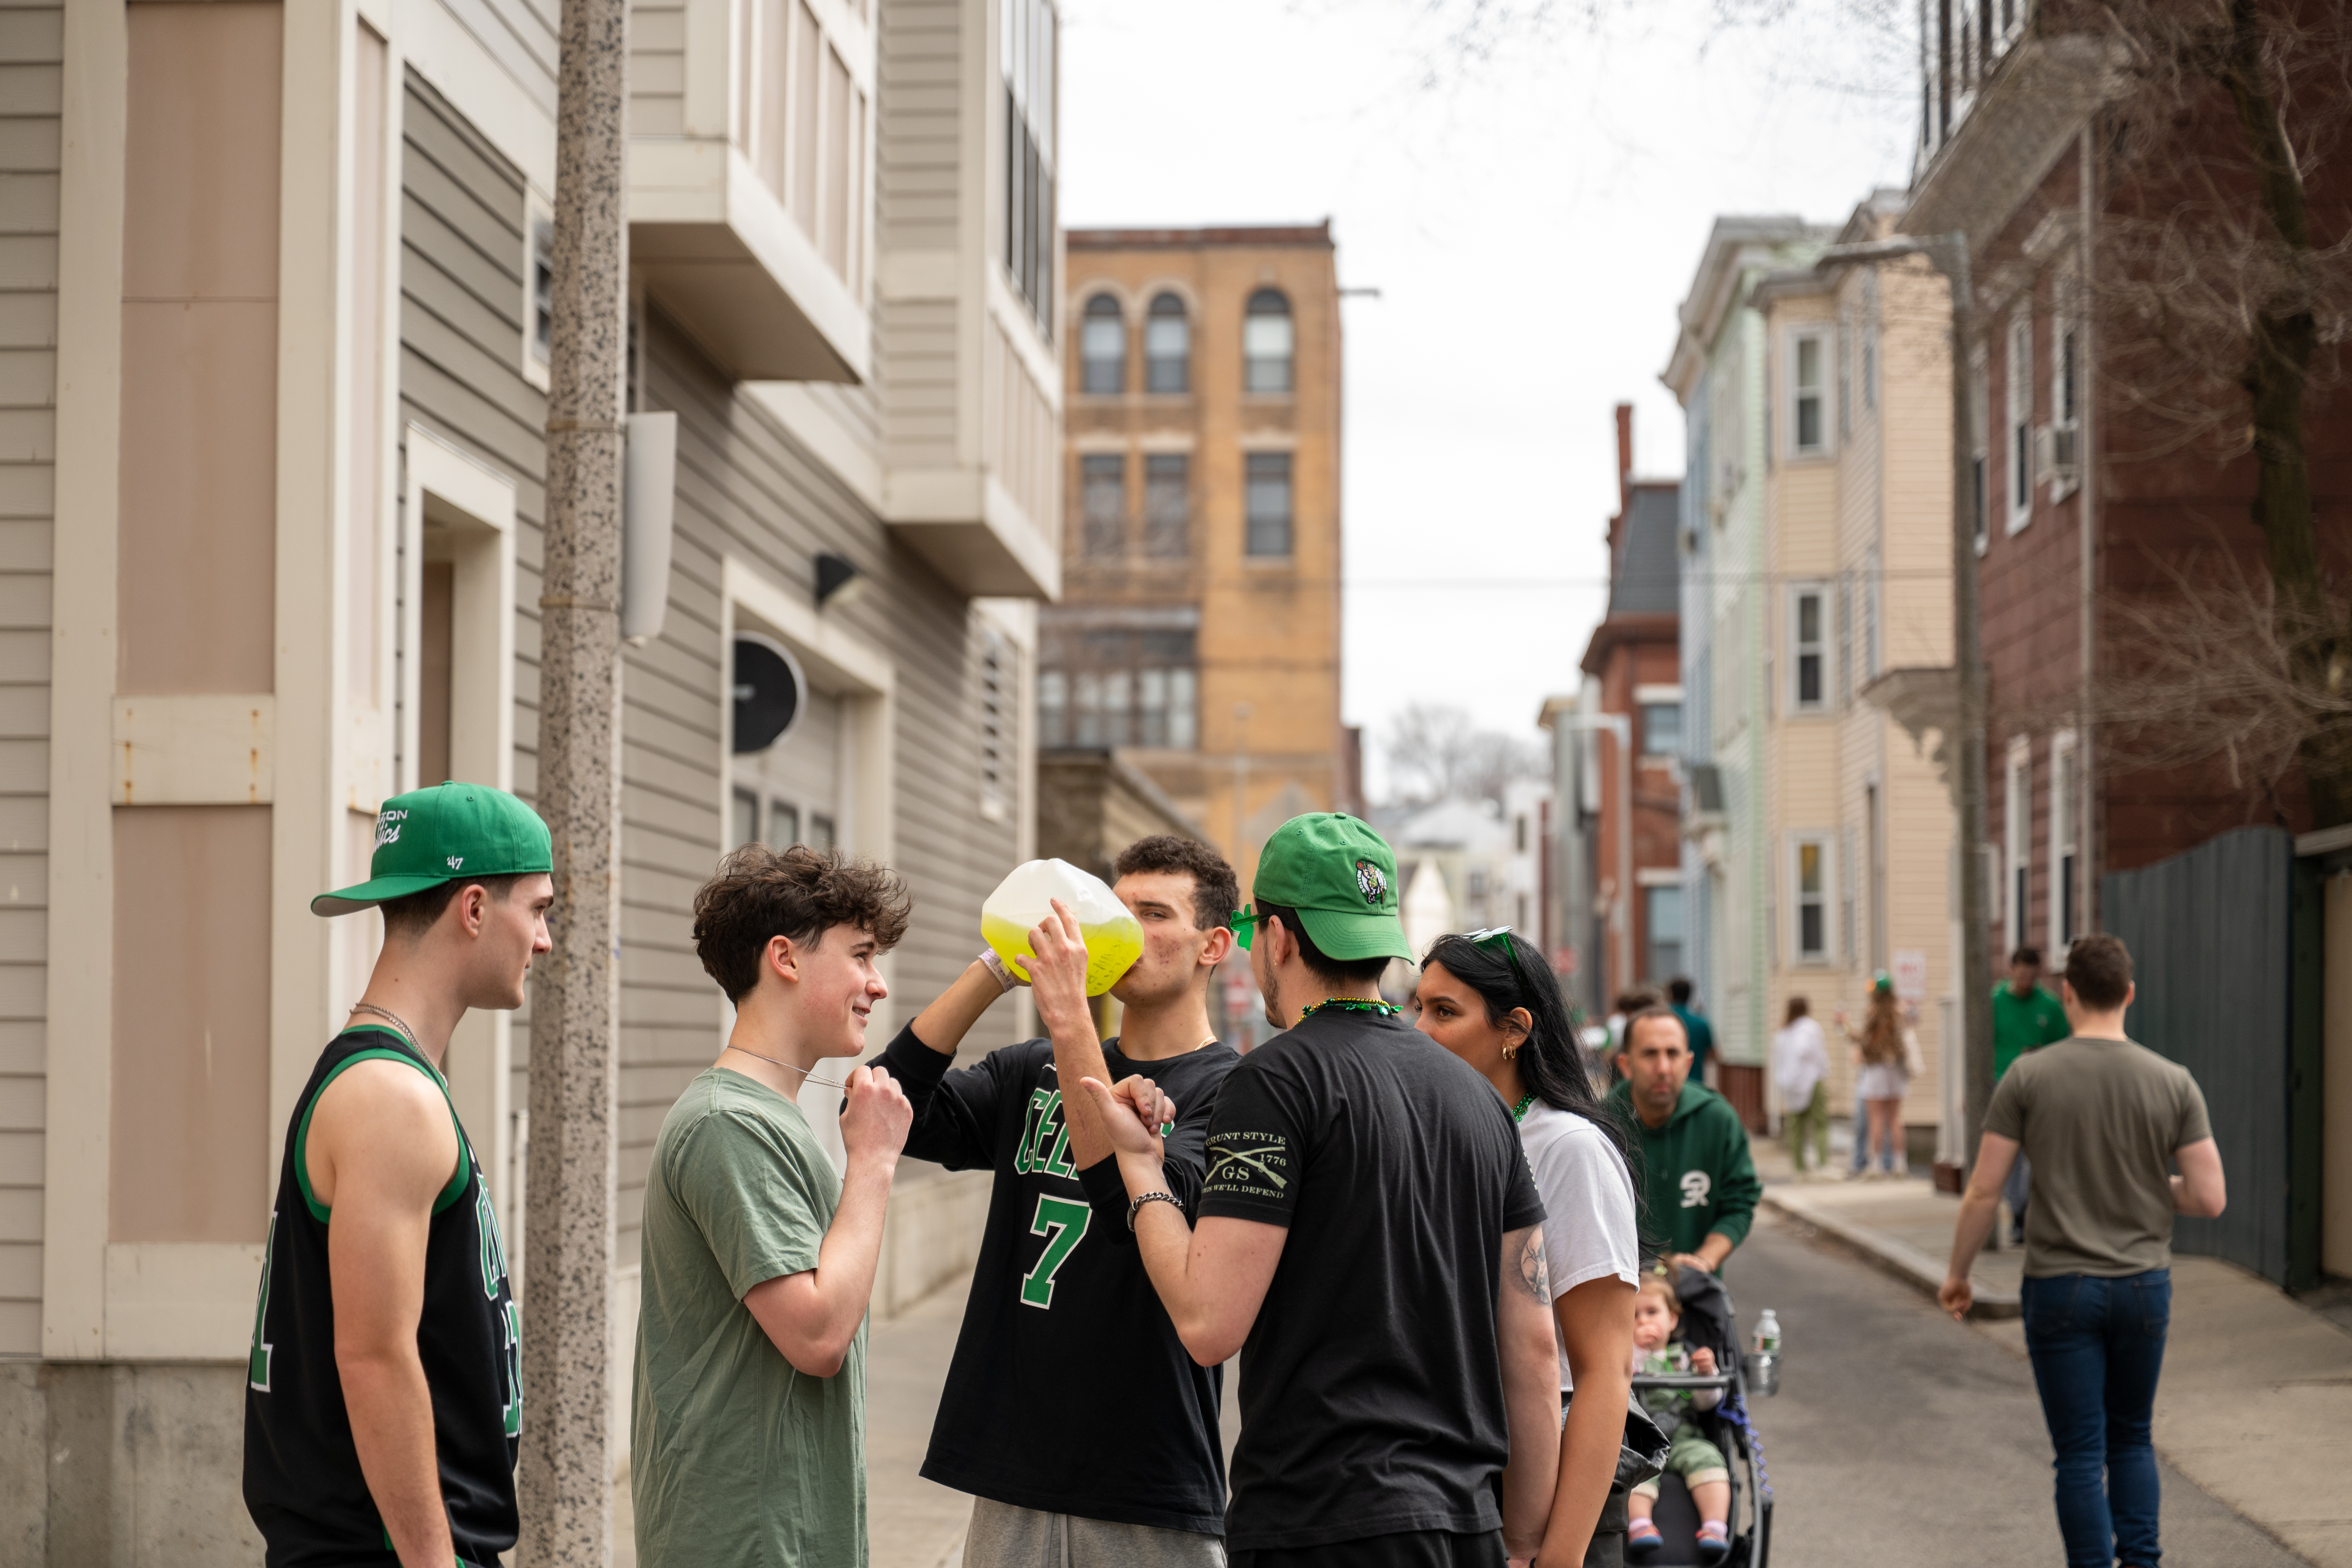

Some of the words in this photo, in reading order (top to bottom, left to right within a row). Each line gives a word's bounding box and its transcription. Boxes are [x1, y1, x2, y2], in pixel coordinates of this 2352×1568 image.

[1357, 869, 1367, 894] BOSTON
[1206, 1132, 1241, 1146] GRUNT
[1243, 1132, 1286, 1145] STYLE
[1259, 1153, 1286, 1167] 1776
[1222, 1166, 1250, 1180] GS
[1241, 1185, 1284, 1199] DEFEND
[1020, 1193, 1092, 1310] 7
